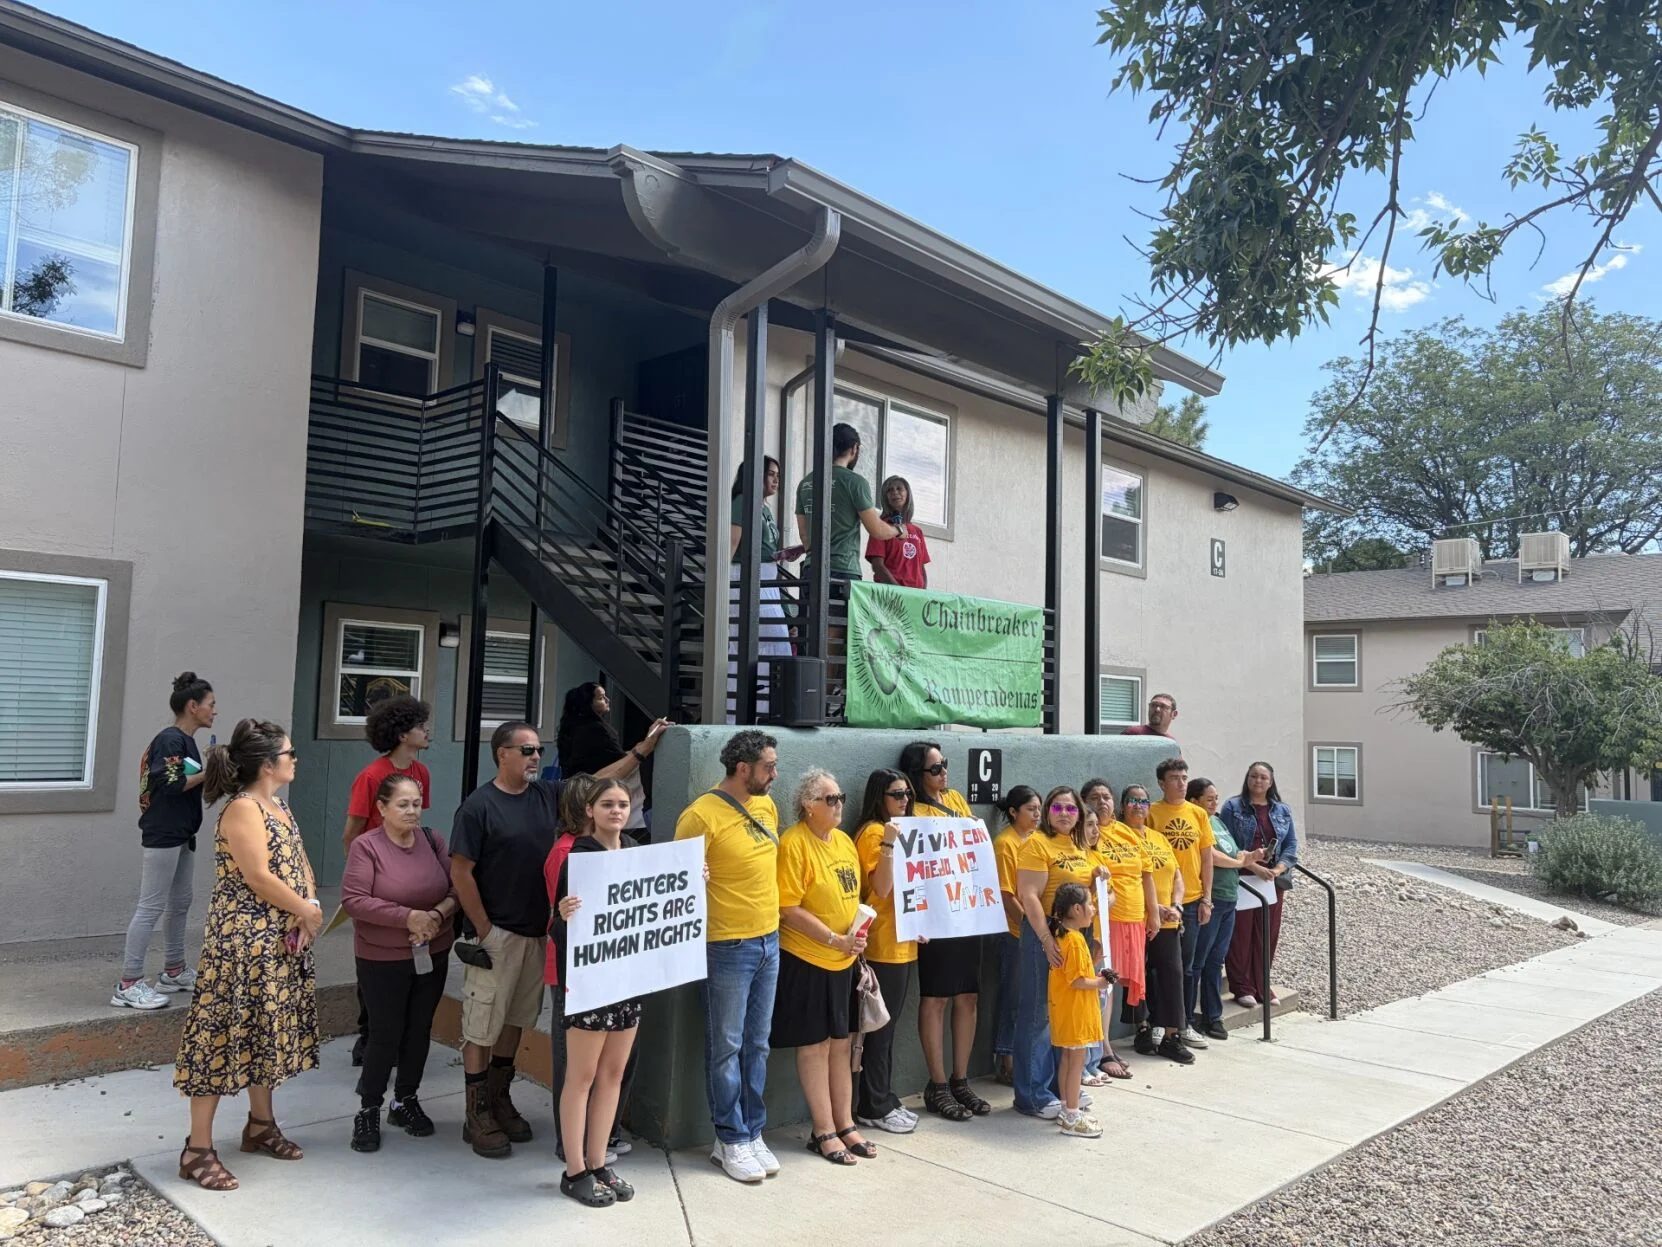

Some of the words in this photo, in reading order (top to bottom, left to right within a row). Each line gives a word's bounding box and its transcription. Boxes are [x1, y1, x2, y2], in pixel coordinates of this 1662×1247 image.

[1214, 541, 1222, 567] C
[921, 599, 1039, 638] Chainbreaker
[923, 677, 1039, 710] Rompecadenas
[979, 750, 992, 782] C
[971, 793, 978, 802] 17
[991, 783, 999, 792] 20
[962, 827, 988, 846] CON
[957, 851, 979, 874] NO
[607, 870, 689, 906] RENTERS
[902, 885, 929, 914] ES
[593, 902, 659, 936] RIGHTS
[662, 895, 696, 921] ARE
[573, 932, 640, 968] HUMAN
[643, 918, 703, 952] RIGHTS
